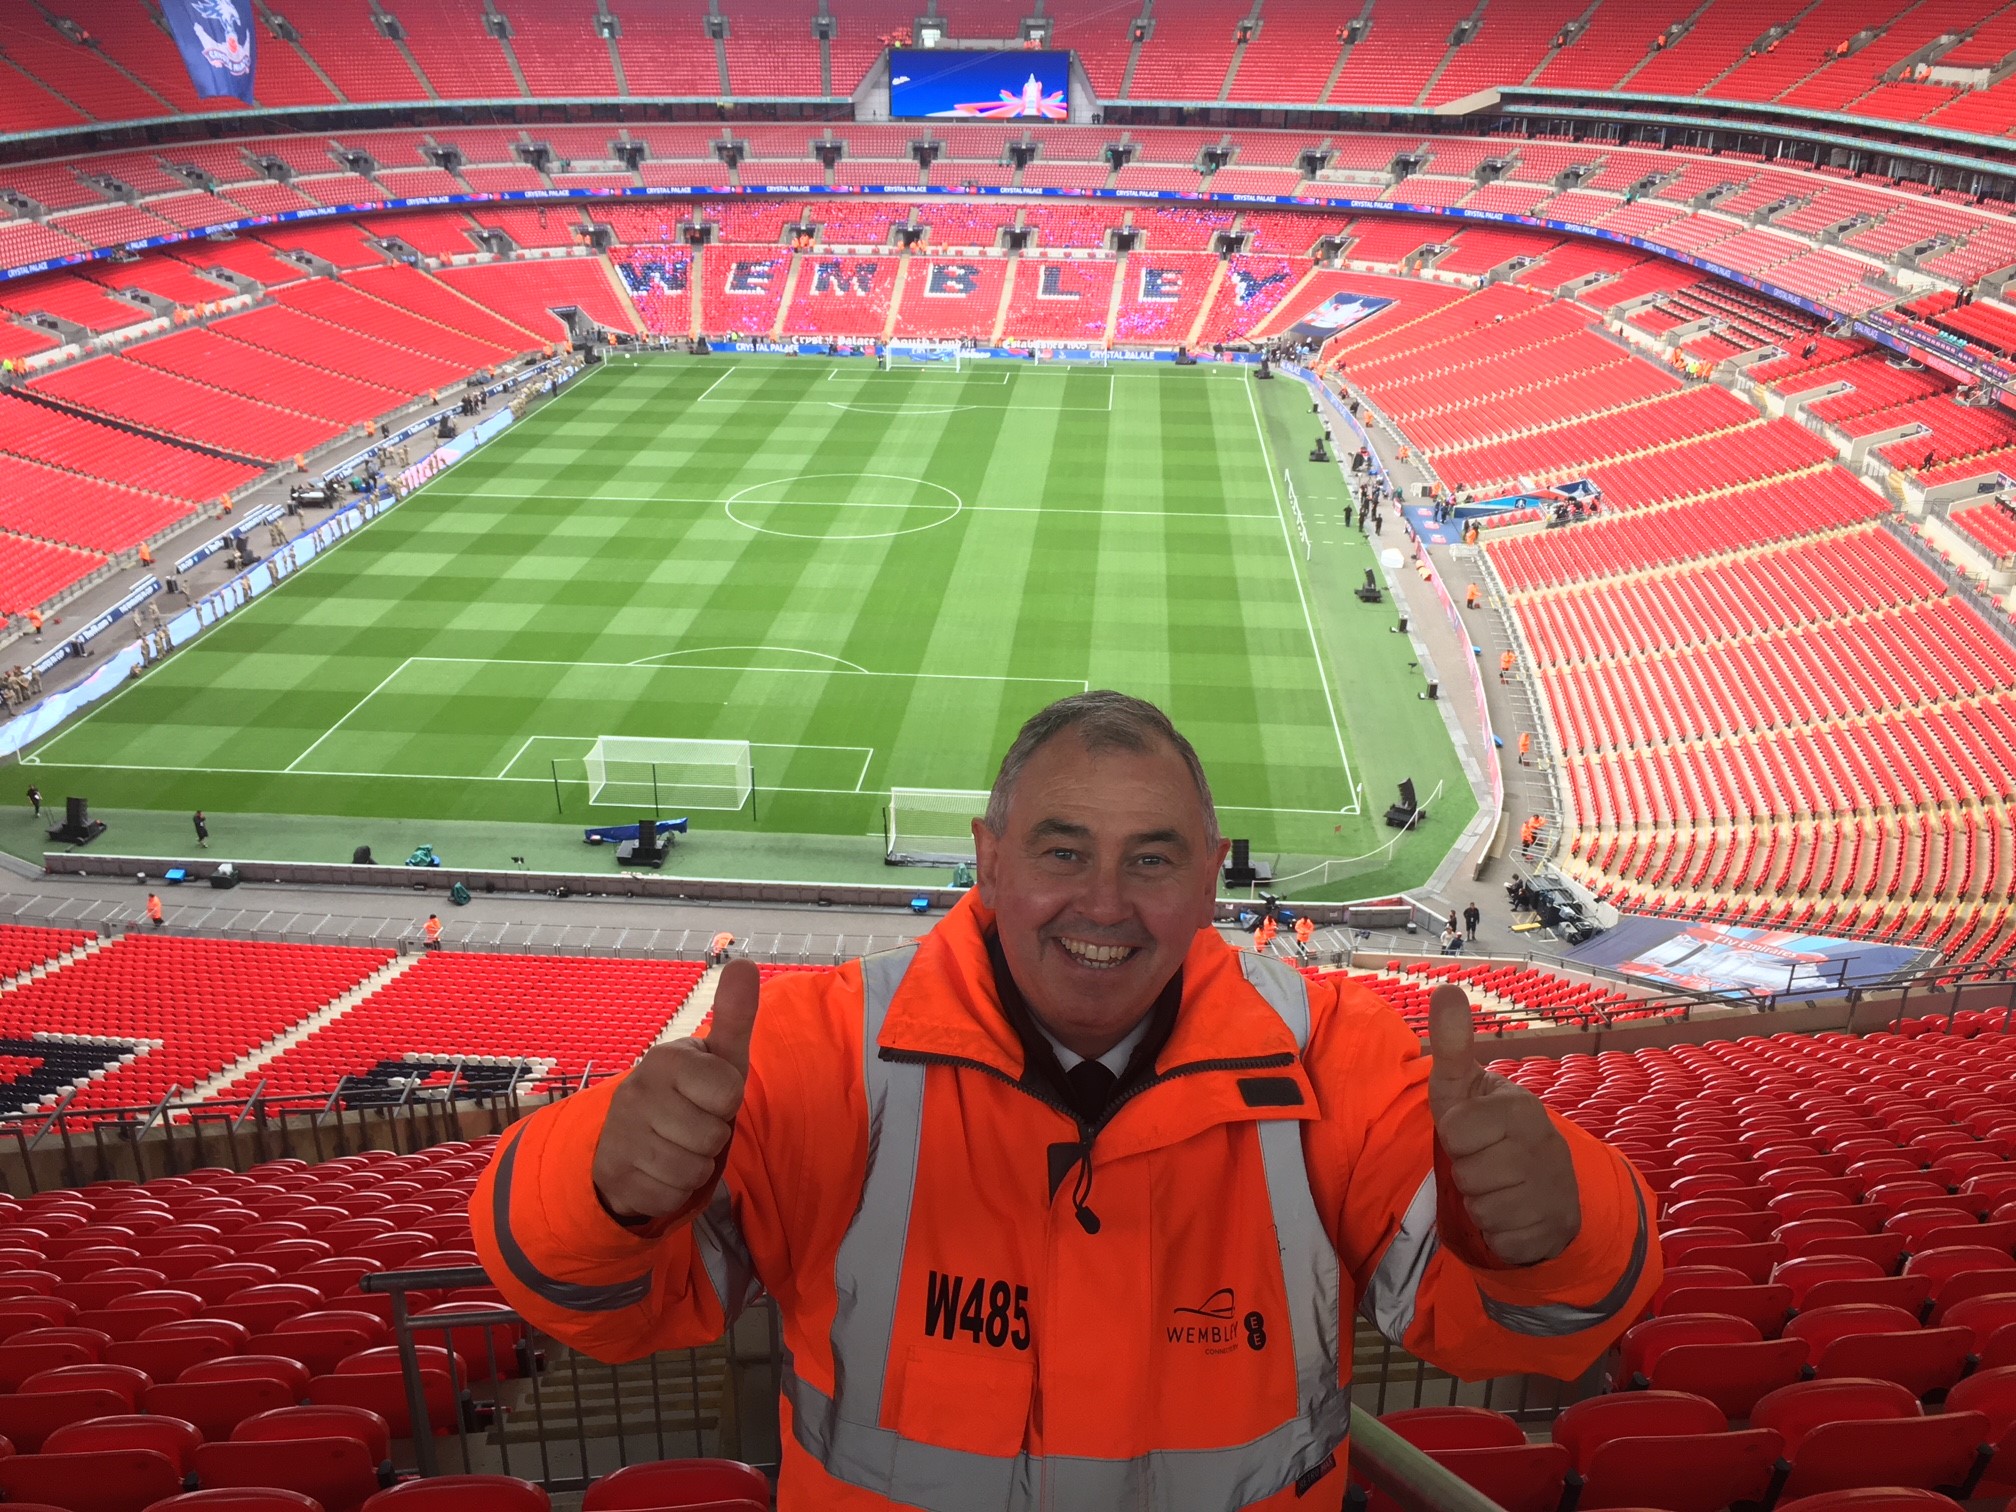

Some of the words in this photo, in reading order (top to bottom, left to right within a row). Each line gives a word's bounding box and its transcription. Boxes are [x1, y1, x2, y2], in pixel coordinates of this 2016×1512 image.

[646, 186, 670, 194] CRYSTAL
[671, 186, 692, 194] PALACE
[1139, 190, 1159, 198] PALACE
[1256, 194, 1276, 202] PALACE
[1351, 200, 1373, 208] CRYSTAL
[1374, 201, 1394, 210] PALACE
[1464, 210, 1484, 219] CRYSTAL
[1485, 211, 1504, 220] PALACE
[8, 266, 30, 278] CRYSTAL
[30, 262, 48, 274] PALACE
[614, 257, 1292, 306] WEMBLEY
[1738, 938, 1797, 959] Emirates
[925, 1269, 1031, 1351] W485
[1166, 1321, 1239, 1344] WEMBLEY
